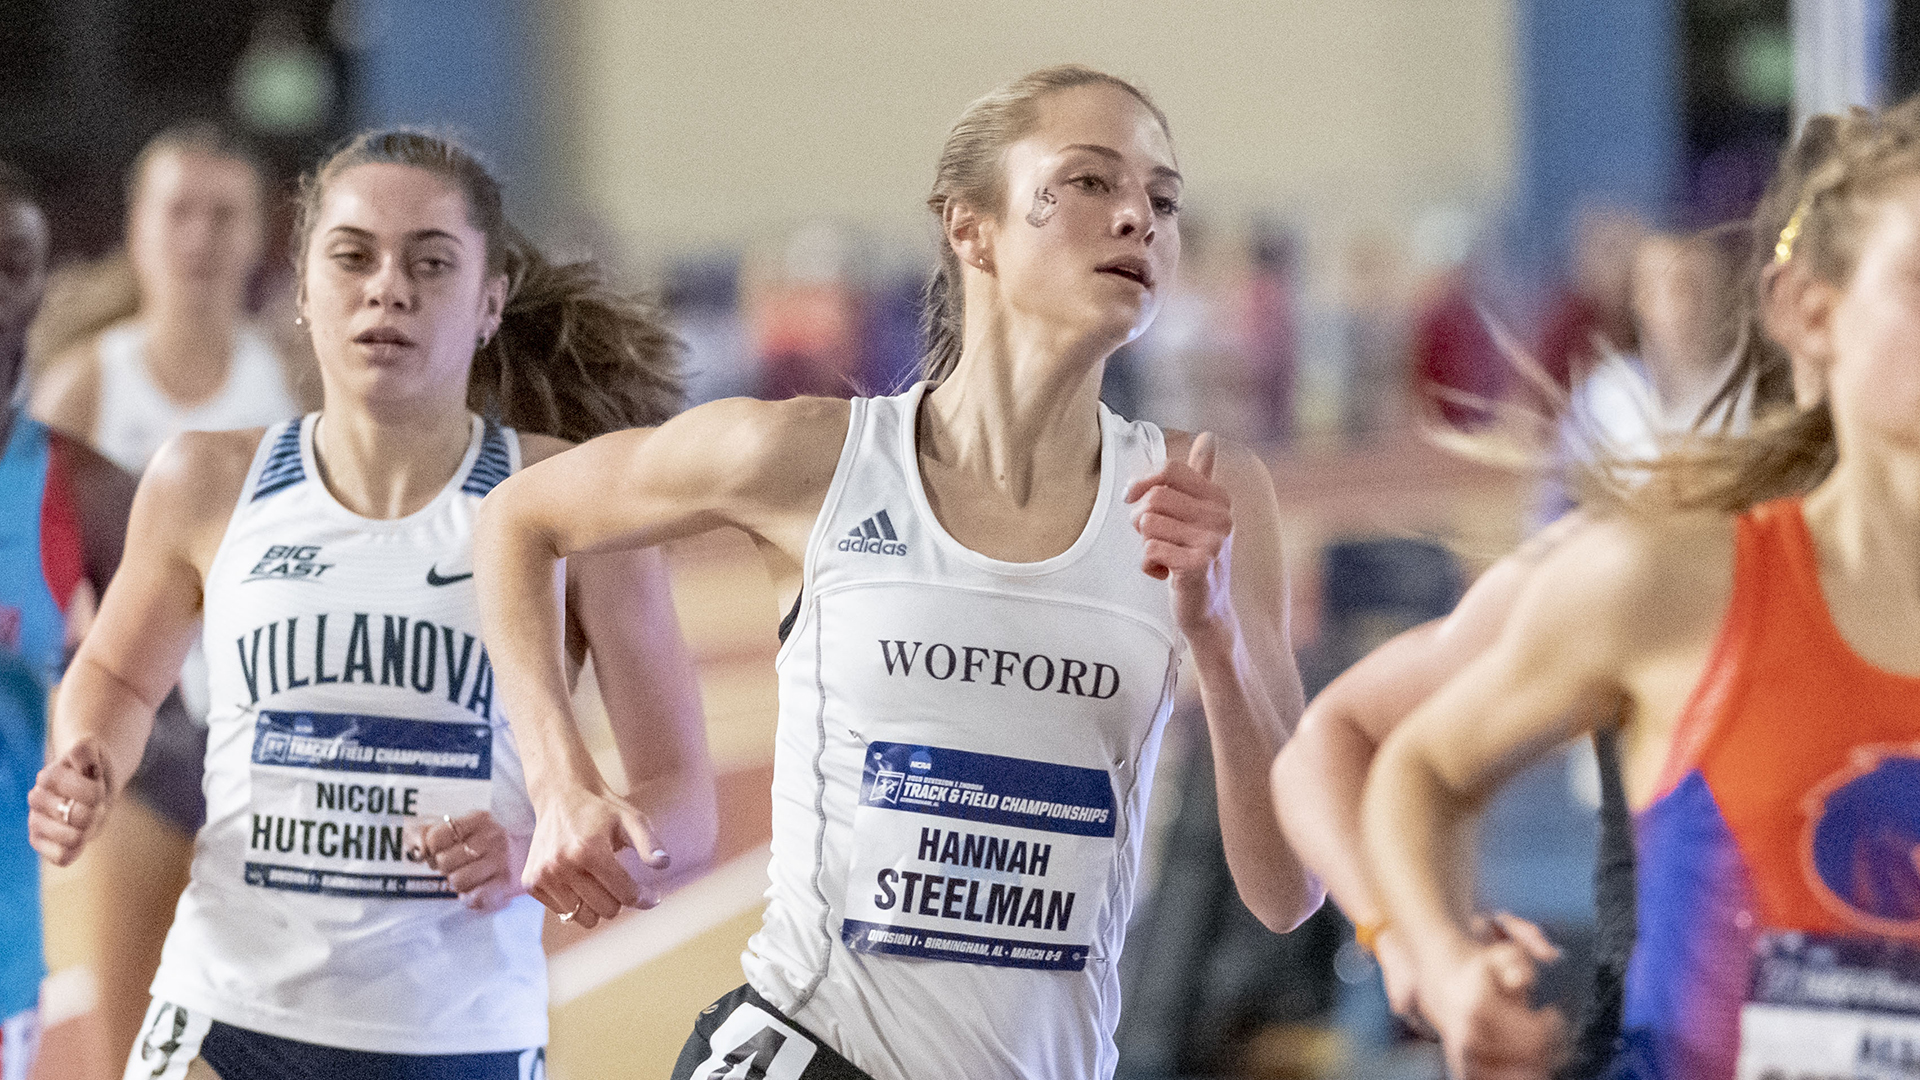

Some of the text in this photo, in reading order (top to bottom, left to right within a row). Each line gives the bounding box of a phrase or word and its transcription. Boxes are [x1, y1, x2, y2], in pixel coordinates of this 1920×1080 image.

[263, 545, 322, 560] BIG
[838, 537, 907, 556] adidas
[250, 561, 335, 577] EAST
[236, 613, 495, 720] VILLANOVA
[878, 639, 1121, 700] WOFFORD
[316, 781, 419, 816] NICOLE
[903, 782, 949, 802] TRACK
[948, 788, 960, 803] &
[960, 790, 1000, 809] FIELD
[1000, 796, 1109, 824] CHAMPIONSHIPS
[917, 826, 1052, 877] HANNAH
[874, 867, 1076, 932] STEELMAN
[867, 929, 912, 946] DIVISION
[924, 937, 990, 956] BIRMINGHAM,
[990, 945, 1004, 957] AL
[1010, 947, 1048, 960] MARCH
[1045, 950, 1062, 962] 8-9
